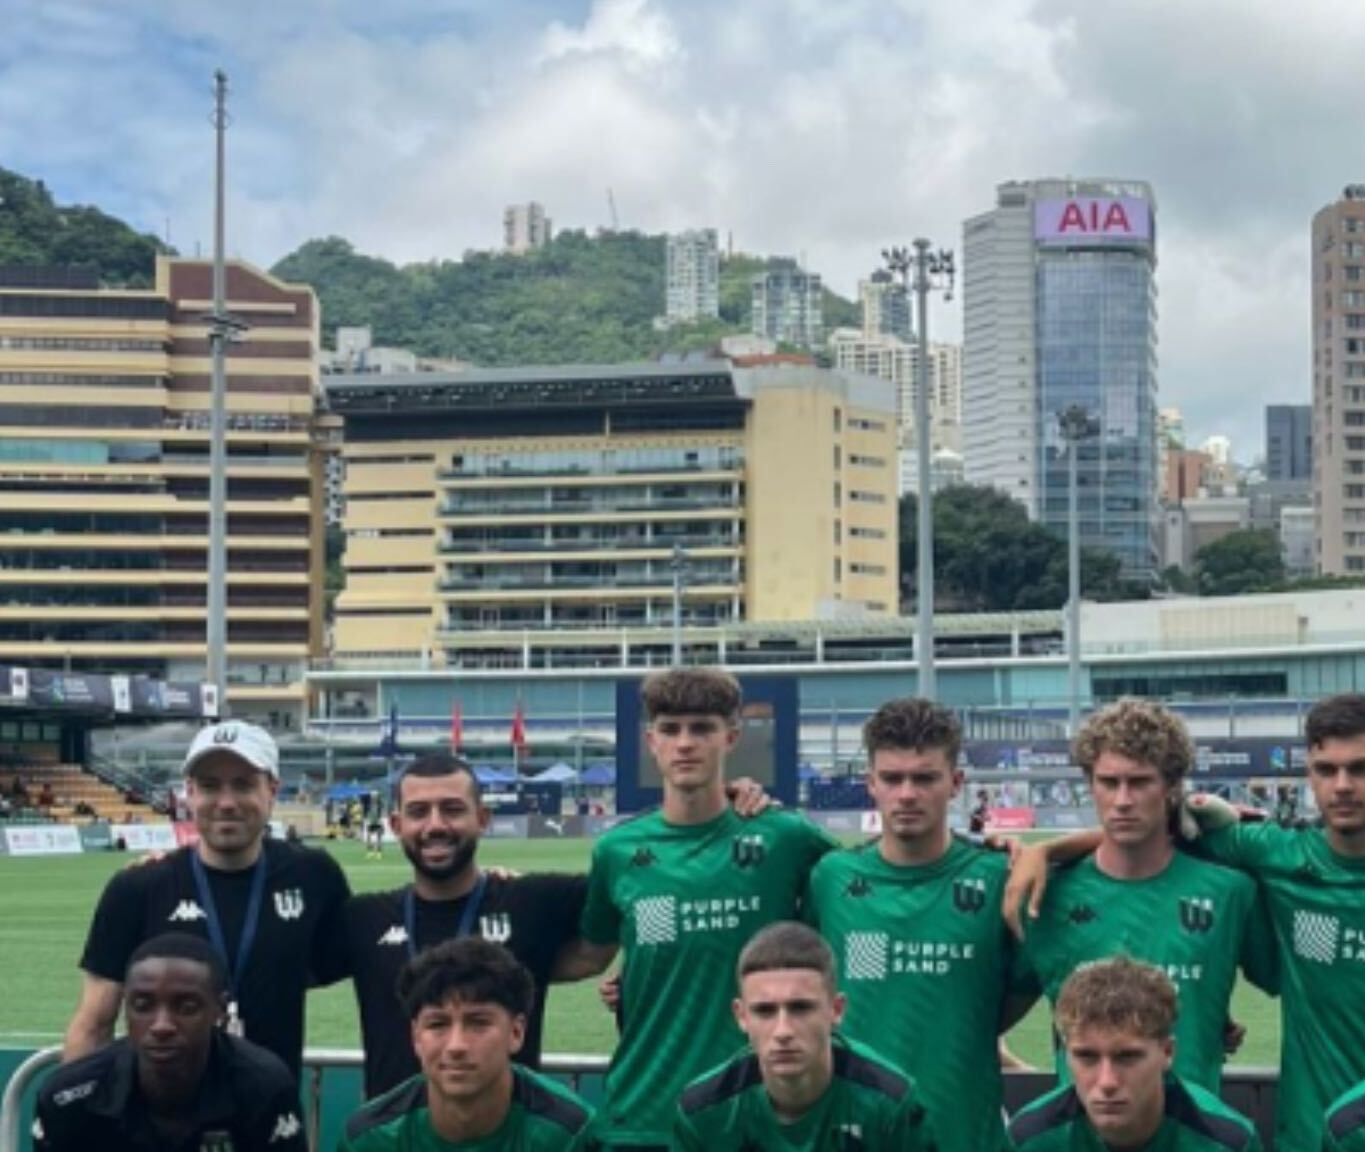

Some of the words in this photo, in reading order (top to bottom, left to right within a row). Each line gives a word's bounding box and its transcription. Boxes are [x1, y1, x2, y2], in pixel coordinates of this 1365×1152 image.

[1057, 202, 1133, 233] AIA
[680, 896, 760, 915] PURPLE
[683, 915, 739, 931] SAND
[893, 940, 975, 959] PURPLE
[893, 958, 950, 973] SAND
[1167, 964, 1203, 979] PLE
